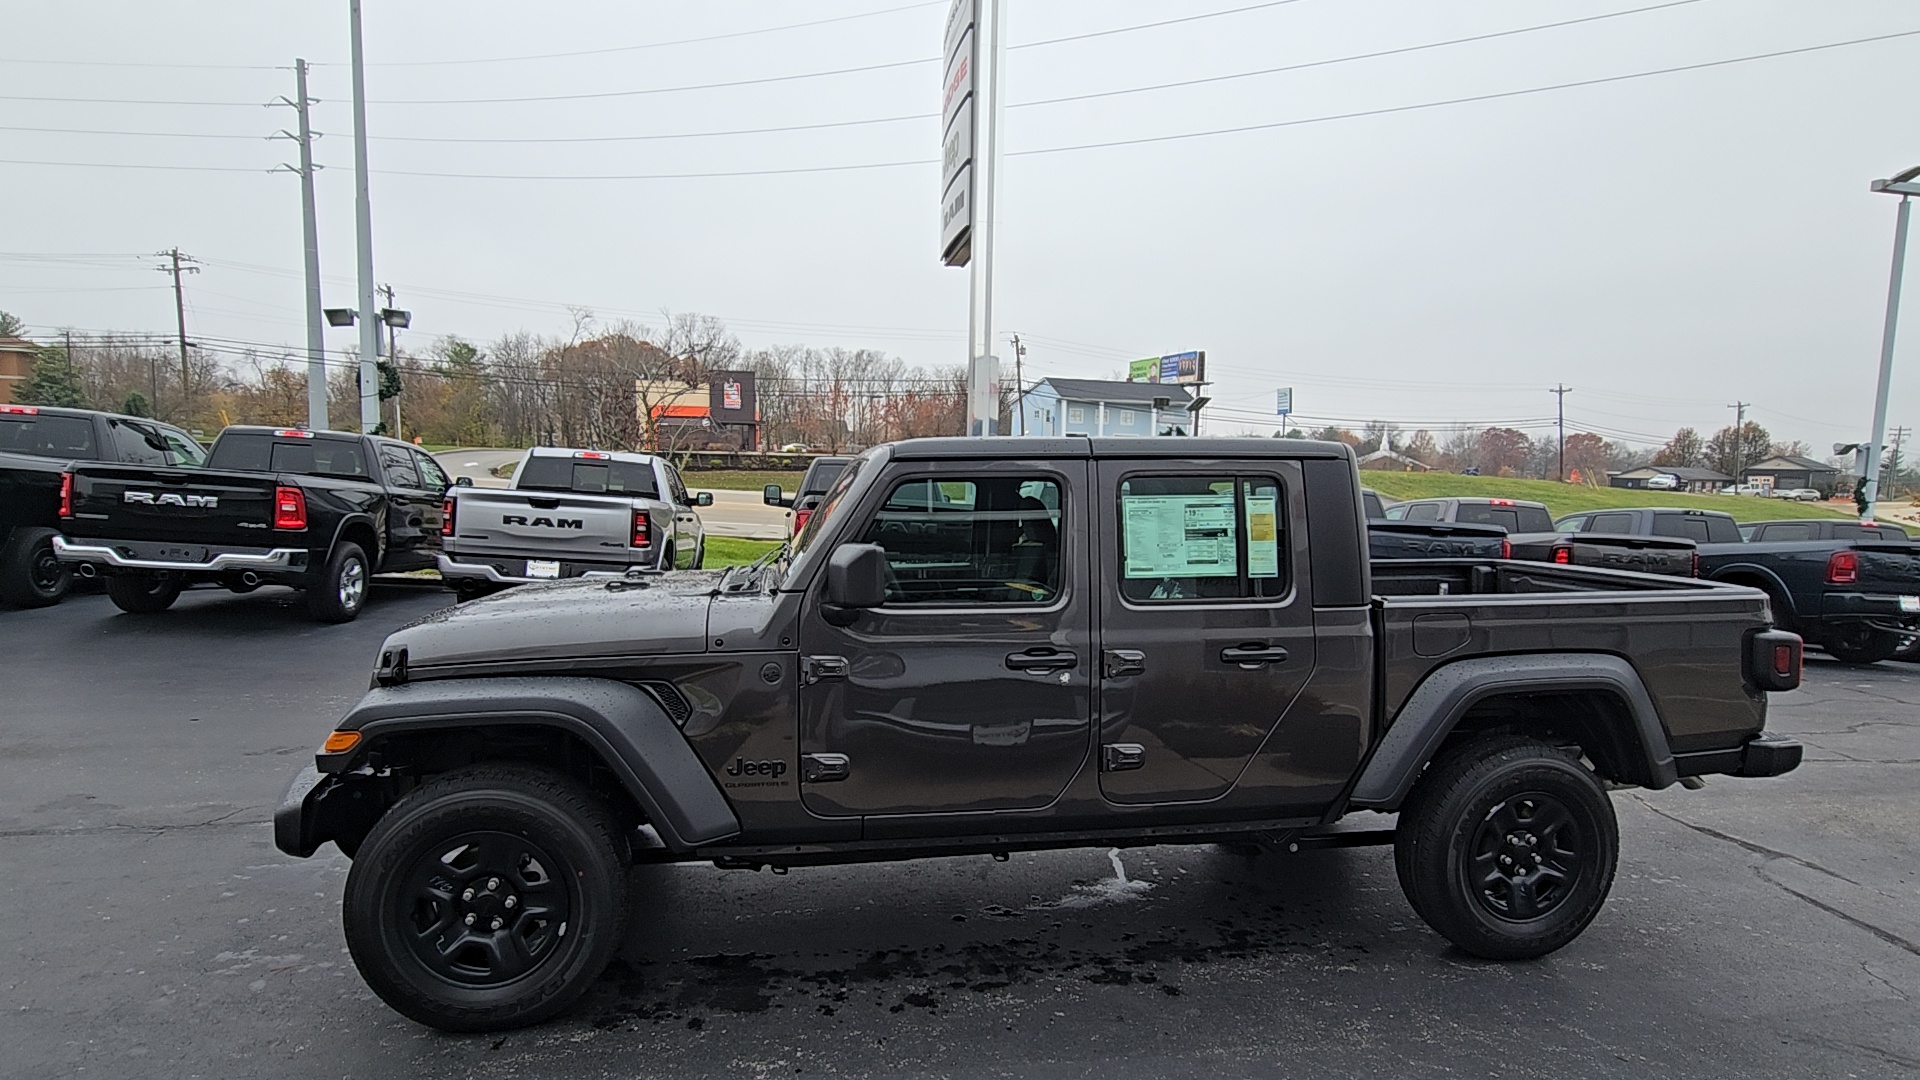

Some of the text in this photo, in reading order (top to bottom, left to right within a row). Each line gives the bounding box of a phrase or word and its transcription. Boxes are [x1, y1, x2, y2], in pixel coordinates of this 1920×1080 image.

[124, 491, 219, 508] RAM
[502, 515, 584, 530] RAM
[880, 521, 938, 534] AM
[1402, 540, 1475, 555] RAM
[1602, 553, 1669, 566] RAM
[726, 756, 787, 778] Jeep
